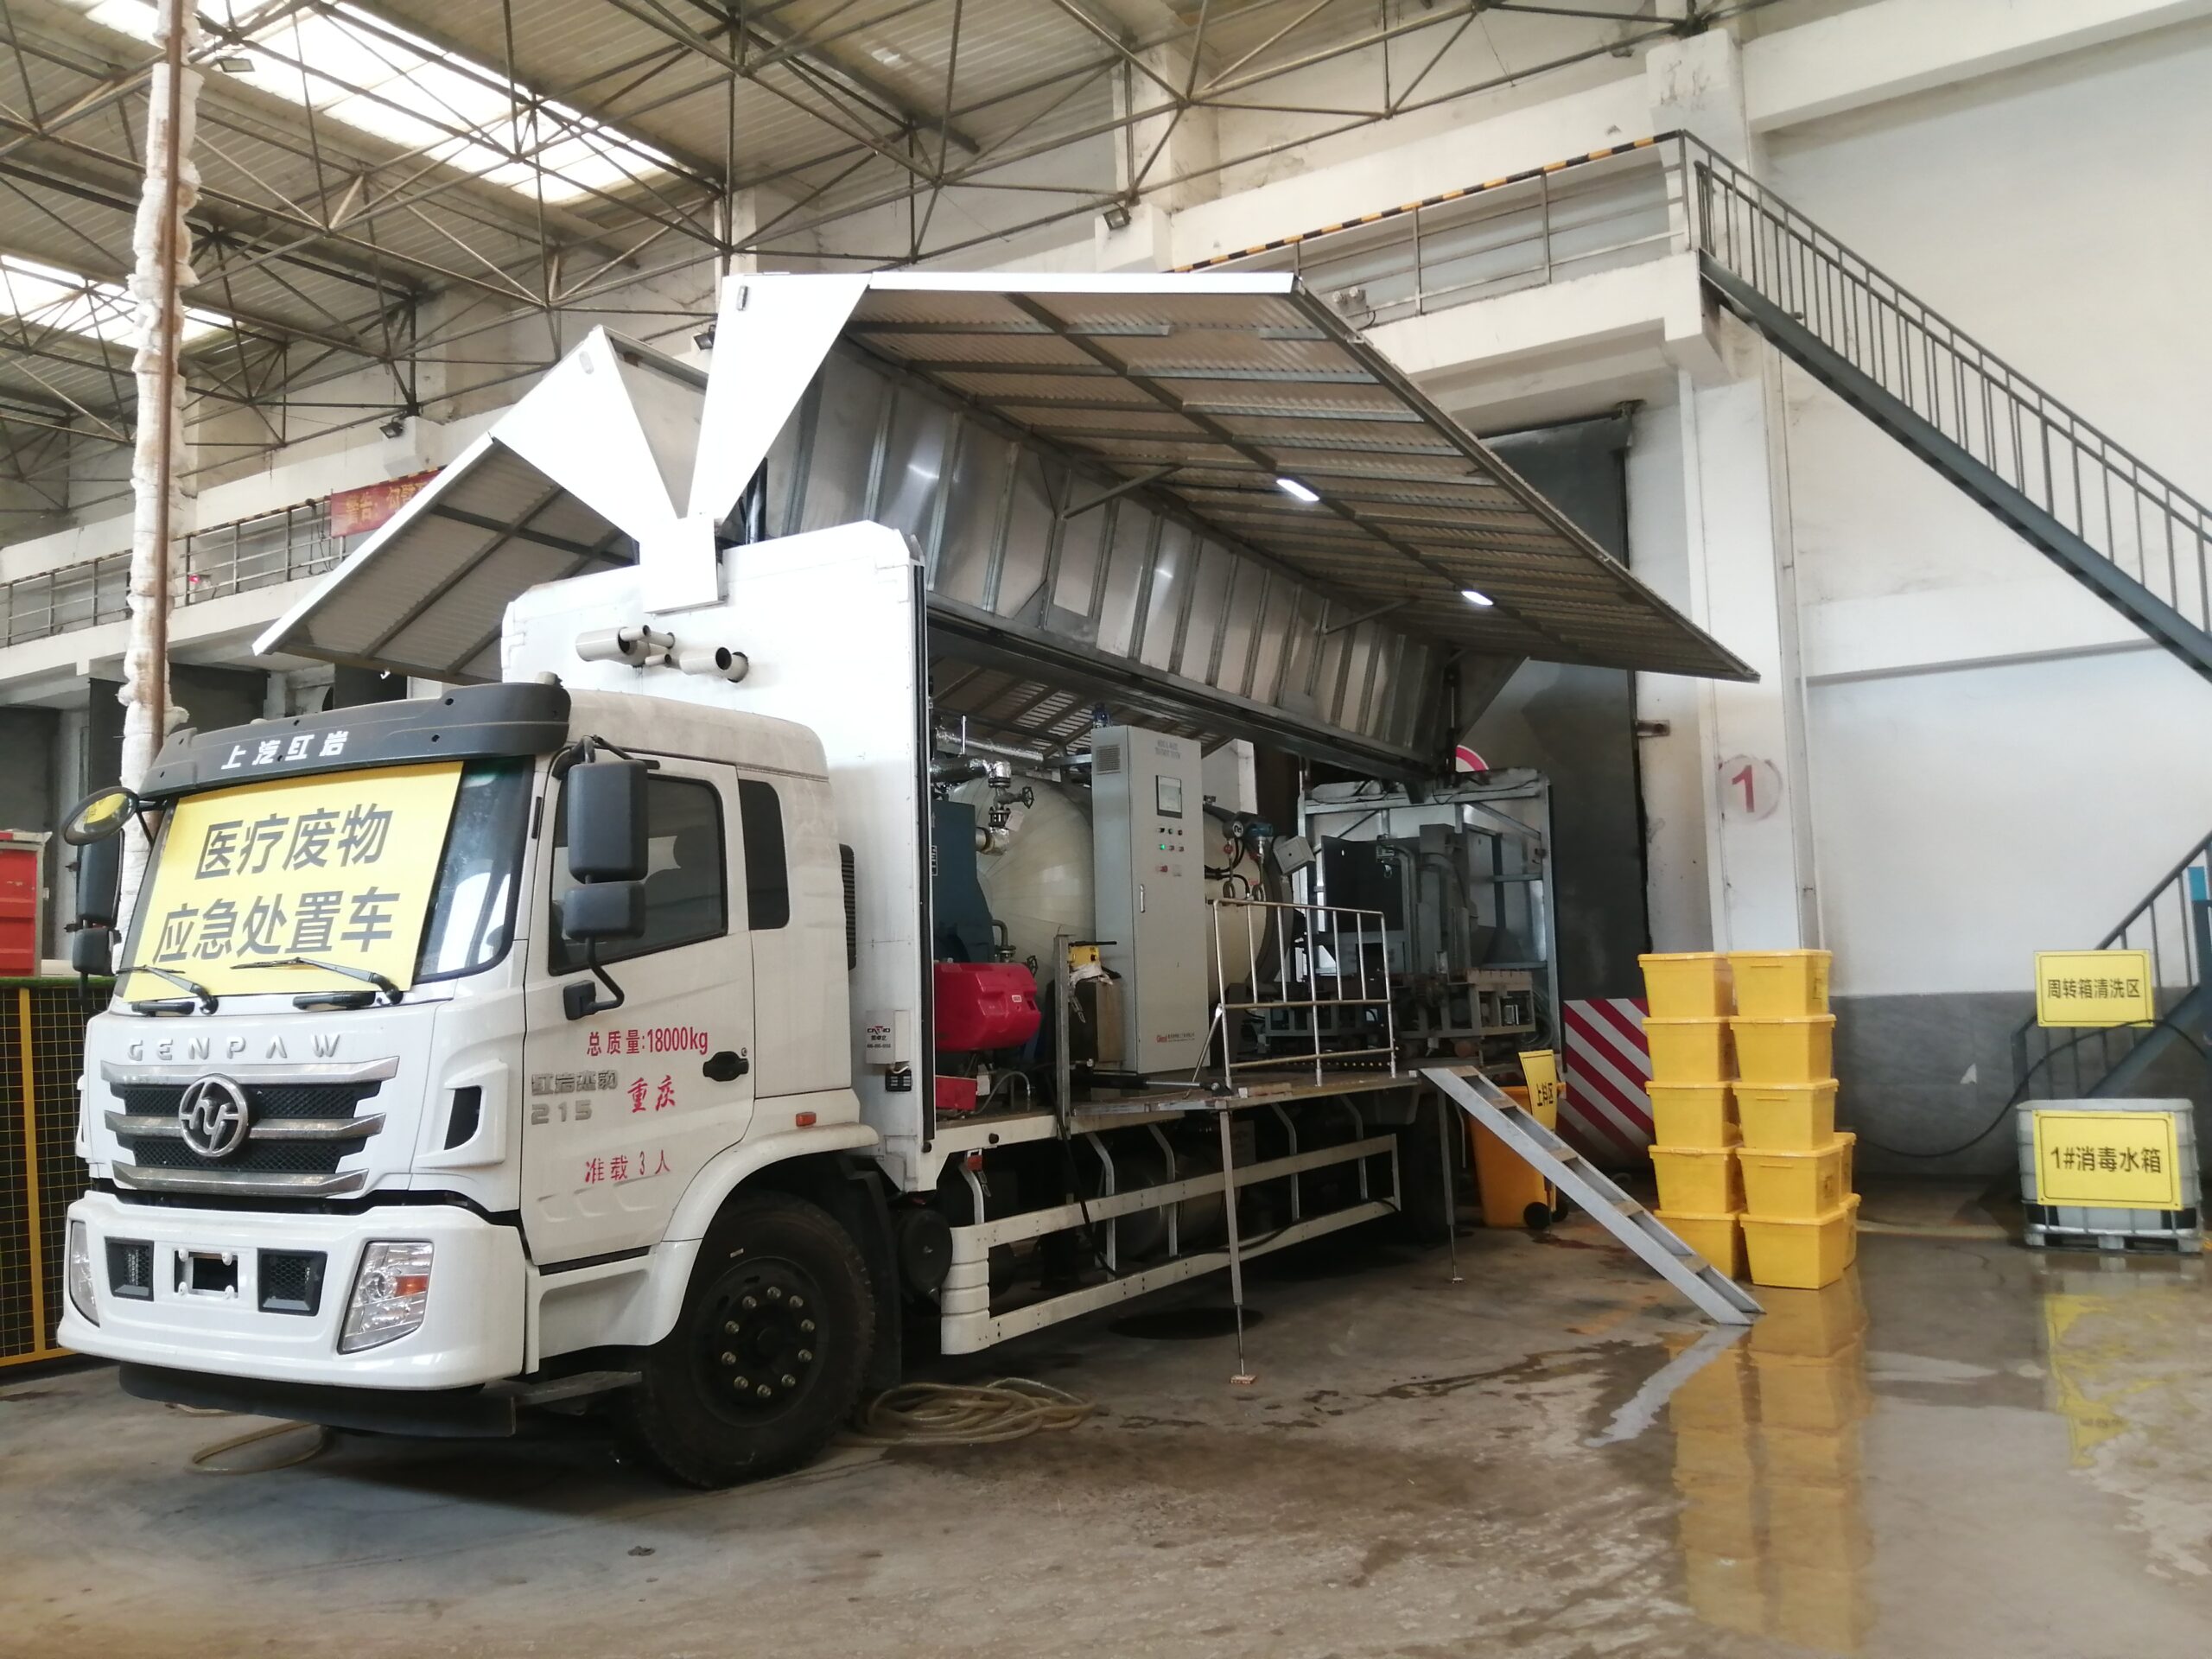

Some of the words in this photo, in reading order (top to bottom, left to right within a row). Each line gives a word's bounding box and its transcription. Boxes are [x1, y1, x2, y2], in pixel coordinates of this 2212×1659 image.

[220, 730, 349, 770] 上汽红岩
[1731, 764, 1755, 813] 1
[194, 803, 393, 880] 医疗废物
[152, 886, 401, 964] 应急处置车
[2047, 977, 2141, 999] 周转箱清洗区
[128, 1033, 341, 1061] GENPAW
[531, 1099, 593, 1125] 215
[627, 1074, 676, 1114] 重庆
[2050, 1146, 2161, 1173] 1#消毒水箱
